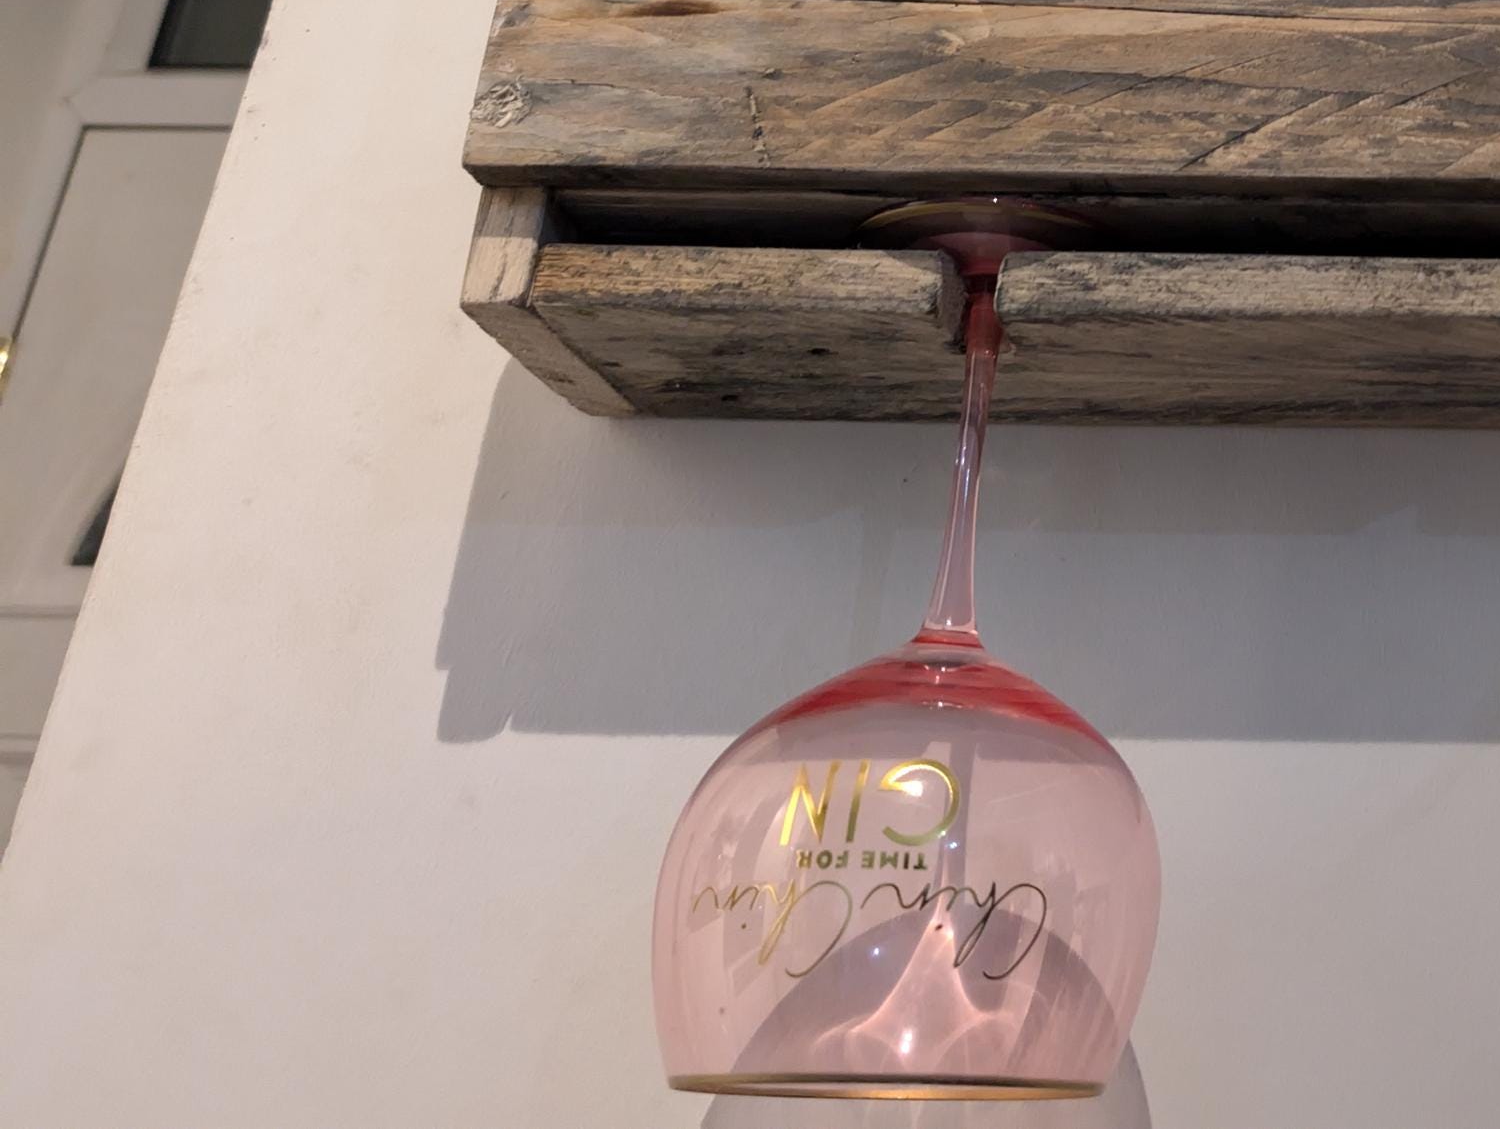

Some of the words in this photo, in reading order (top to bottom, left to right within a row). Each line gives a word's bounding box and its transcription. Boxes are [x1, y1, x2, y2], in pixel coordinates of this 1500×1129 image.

[779, 758, 960, 847] GIN
[797, 850, 849, 870] FOR
[861, 850, 928, 870] TIME
[692, 878, 852, 978] Chin
[861, 881, 1047, 980] Chin
